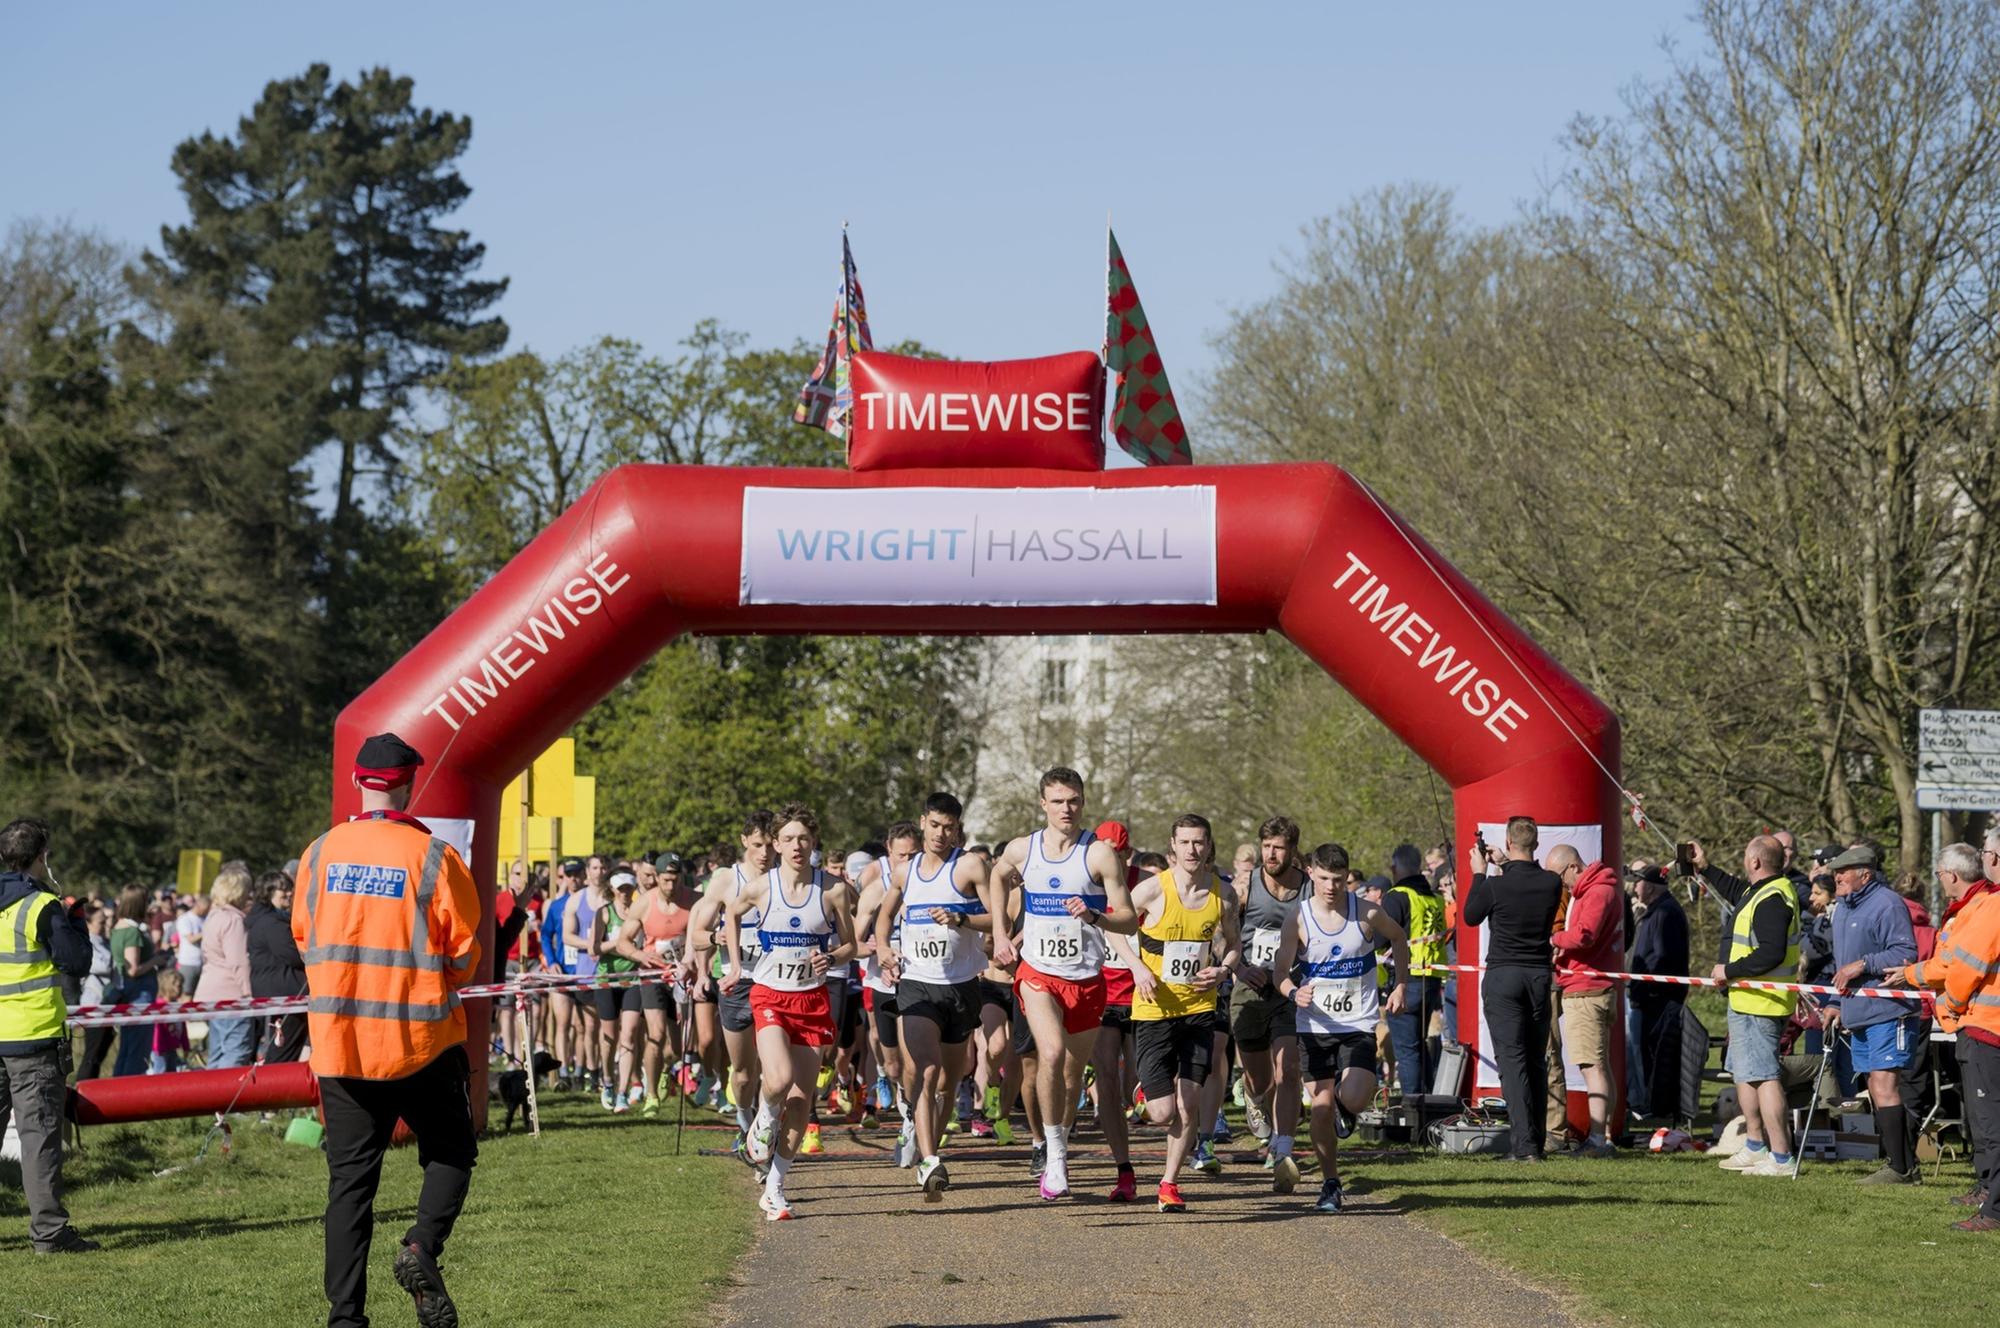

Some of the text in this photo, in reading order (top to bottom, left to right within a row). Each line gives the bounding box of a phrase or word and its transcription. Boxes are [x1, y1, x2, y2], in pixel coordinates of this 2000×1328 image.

[860, 392, 1091, 431] TIMEWISE
[777, 528, 1182, 561] WRIGHT HASSALL
[422, 551, 631, 731] TIMEWISE
[1333, 551, 1530, 743] TIMEWISE
[1936, 793, 1967, 803] Town
[329, 865, 404, 882] LOWLAND
[334, 879, 396, 895] RESCUE
[915, 940, 948, 958] 1607
[1040, 938, 1079, 958] 1285
[778, 963, 813, 980] 1721
[1171, 959, 1200, 977] 890
[1323, 994, 1353, 1012] 466
